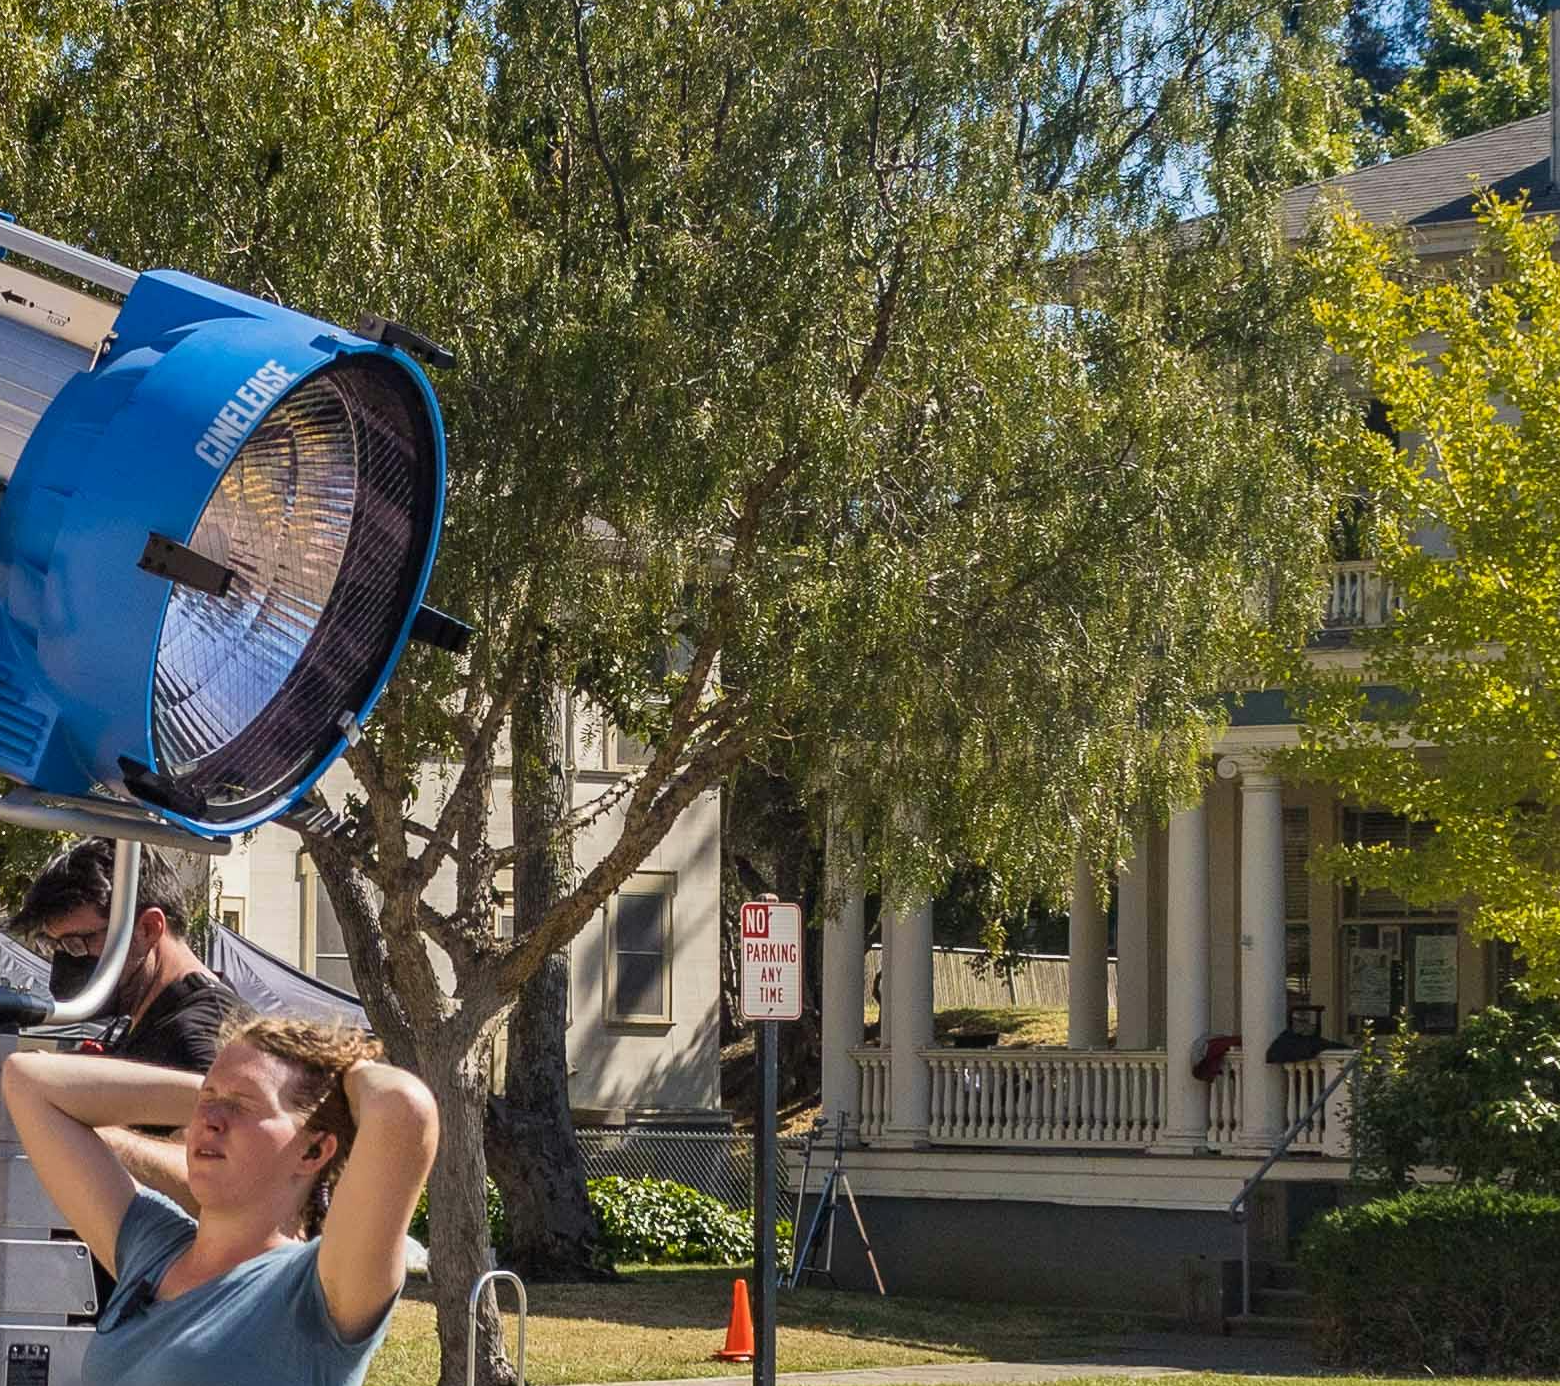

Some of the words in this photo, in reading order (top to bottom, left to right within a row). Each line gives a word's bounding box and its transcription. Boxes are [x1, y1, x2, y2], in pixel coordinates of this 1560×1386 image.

[195, 359, 299, 469] CINELEASE
[745, 908, 766, 934] NO
[746, 943, 797, 963] PARKING
[760, 967, 782, 983] ANY
[760, 987, 784, 1003] TIME
